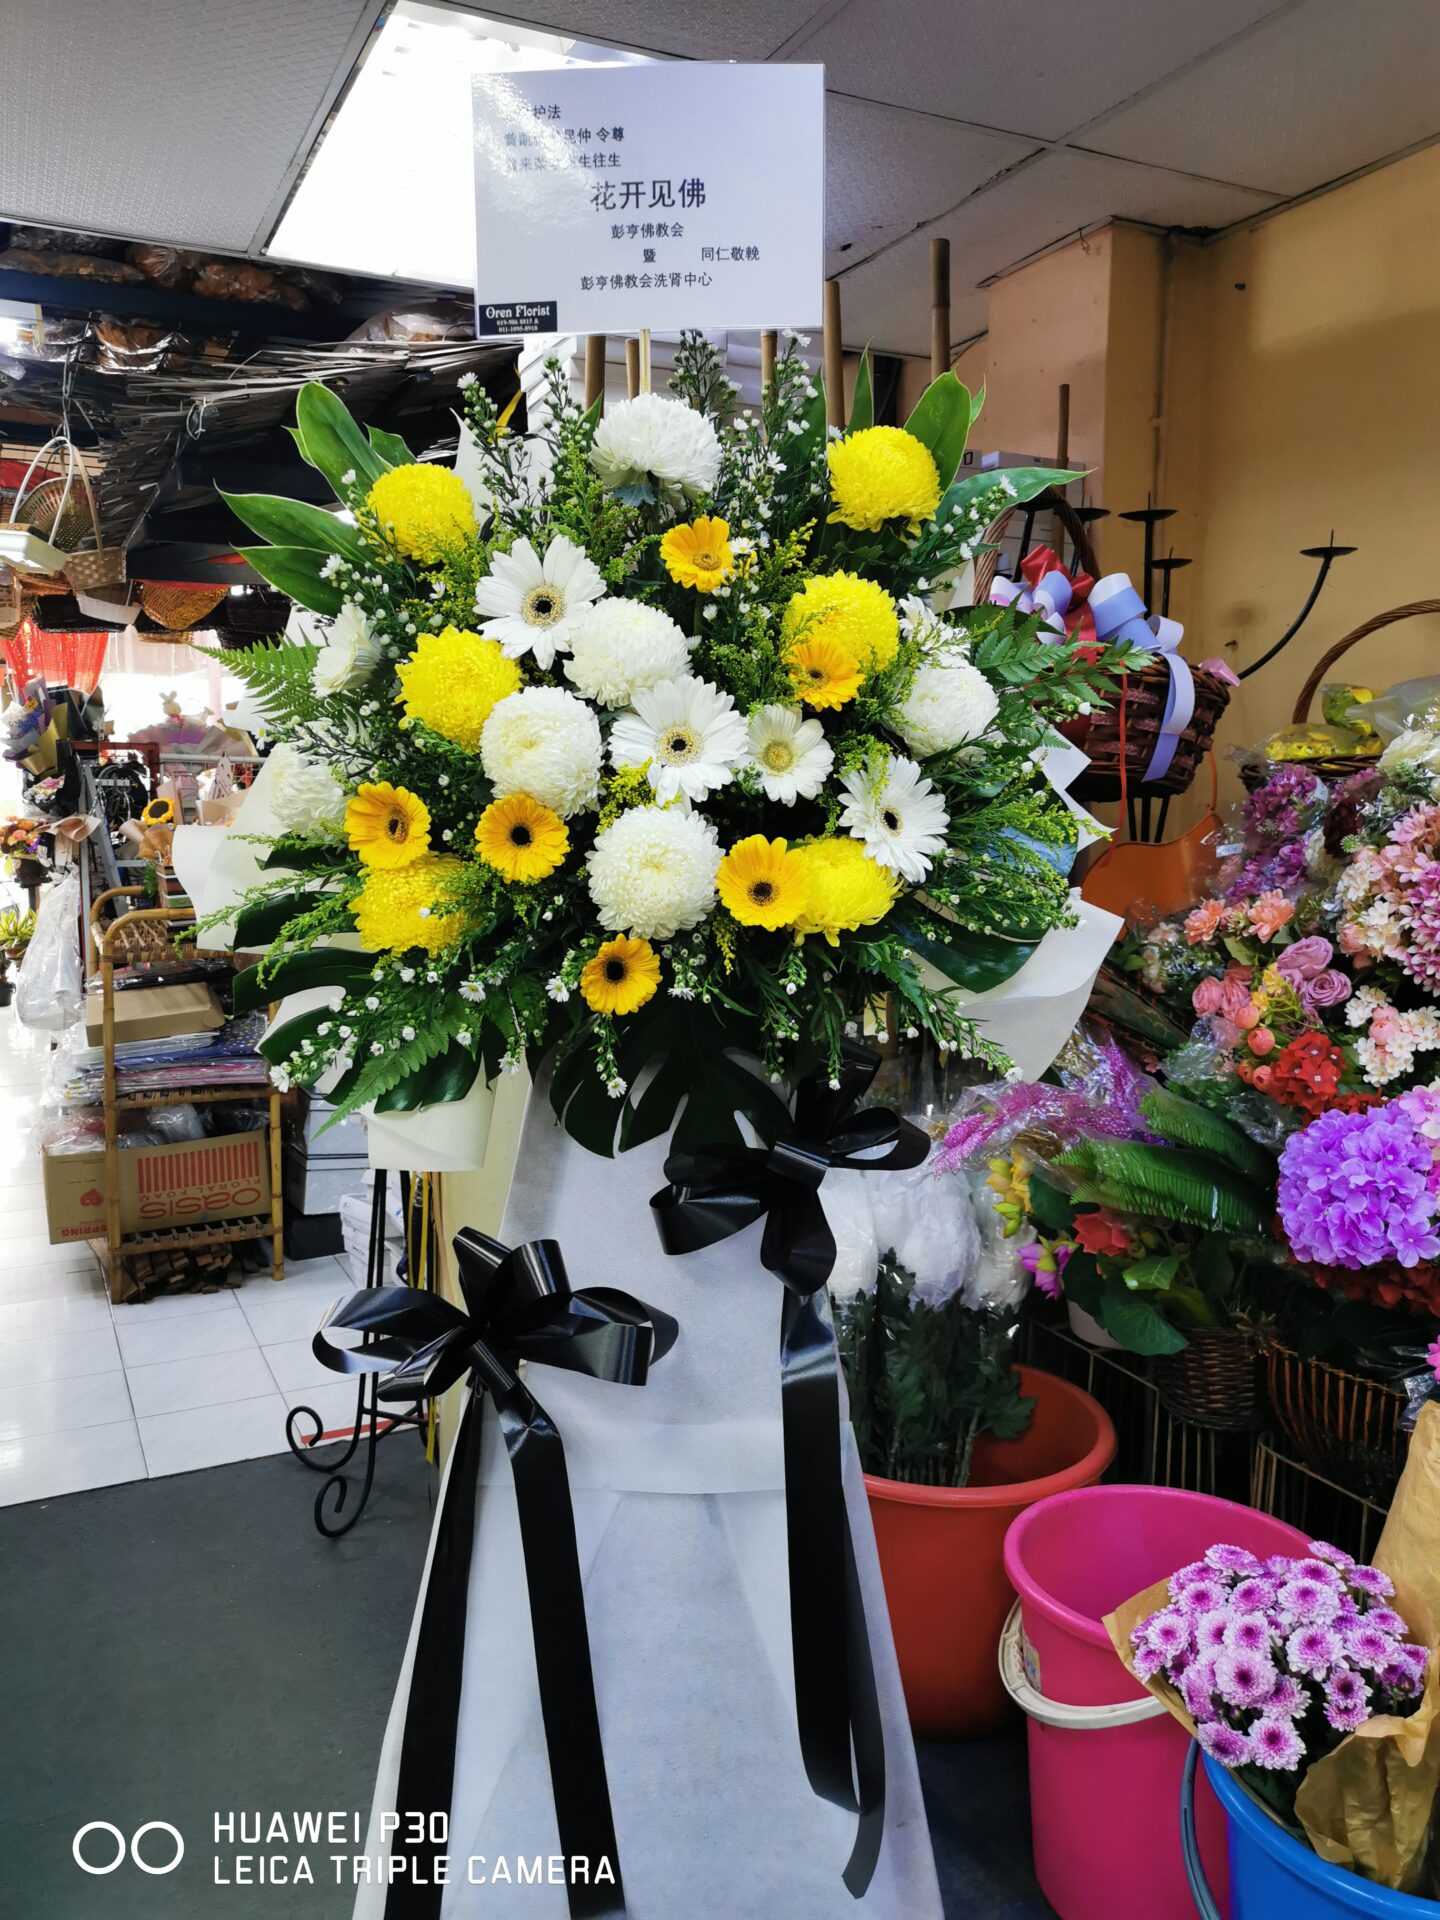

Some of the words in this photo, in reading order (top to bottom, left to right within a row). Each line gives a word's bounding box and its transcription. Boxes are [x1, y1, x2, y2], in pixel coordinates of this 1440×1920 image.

[596, 126, 625, 143] 令尊
[591, 177, 707, 212] 花开见佛
[610, 222, 685, 239] 彭亨佛教会
[580, 271, 713, 291] 彭亨佛教会洗肾中心
[486, 306, 512, 318] Oren
[515, 305, 550, 317] Florist
[198, 1178, 262, 1193] FLORAL
[139, 1190, 188, 1202] FOAM
[61, 1224, 107, 1238] SPRING
